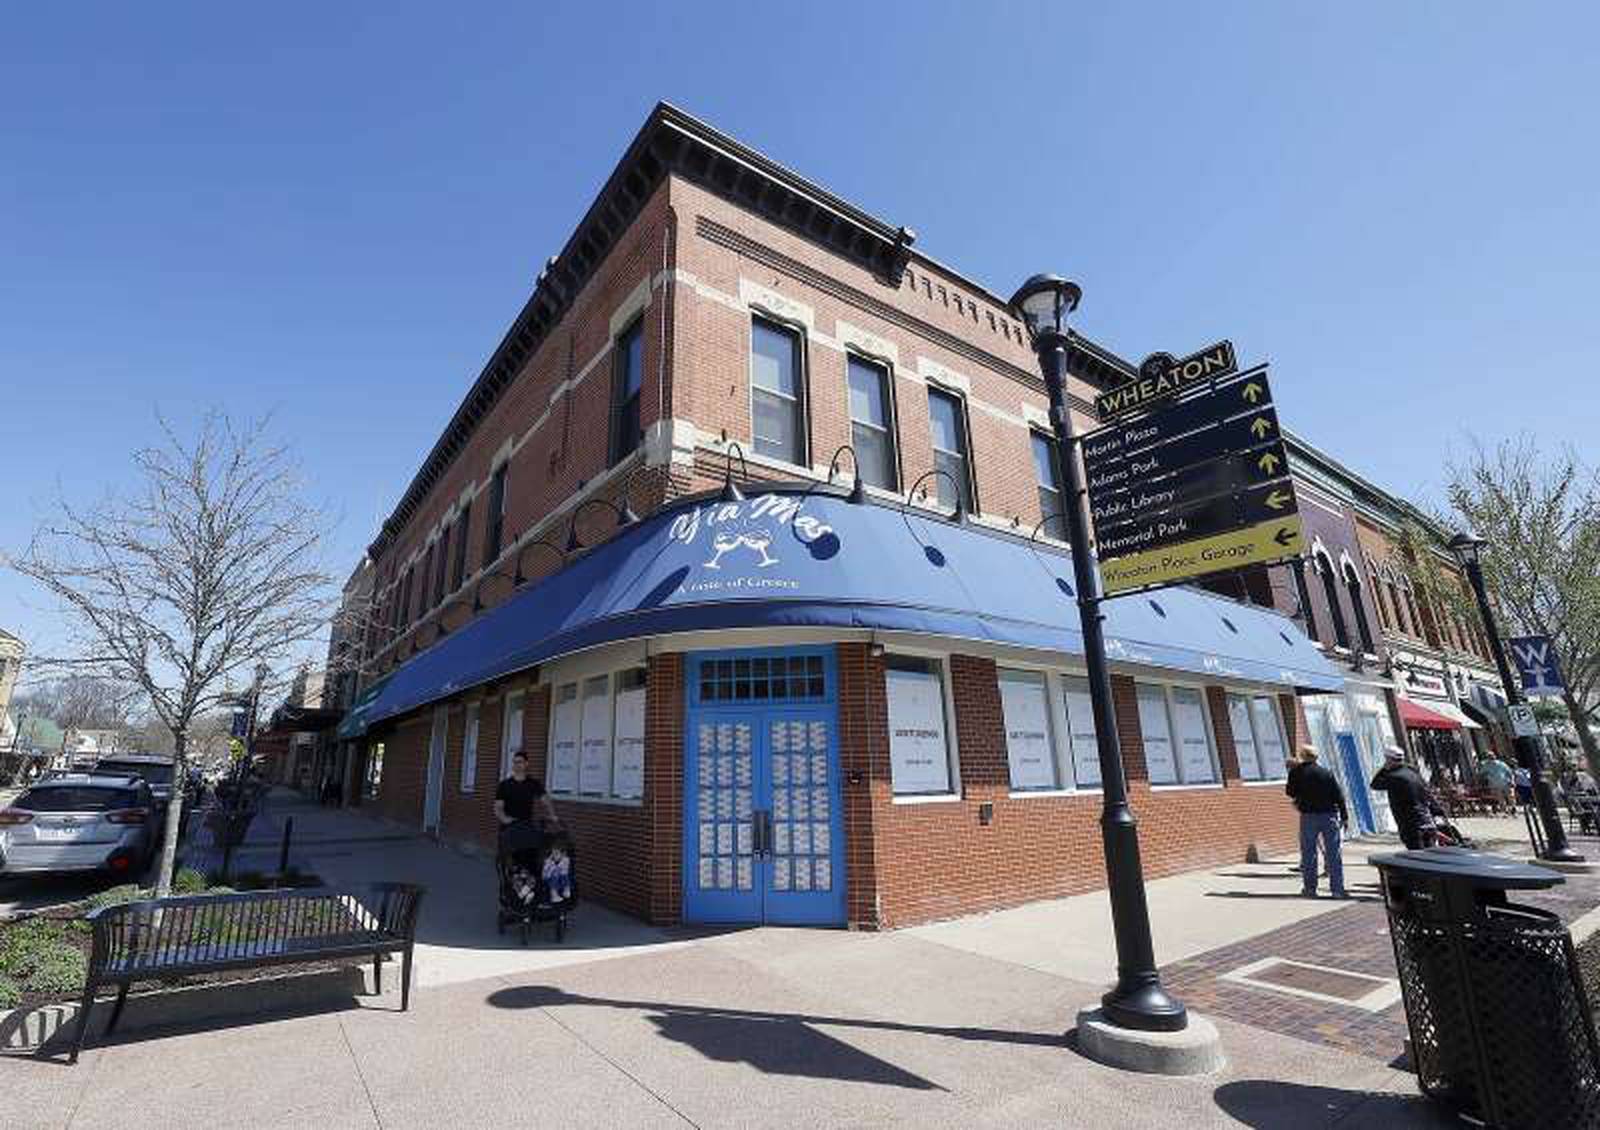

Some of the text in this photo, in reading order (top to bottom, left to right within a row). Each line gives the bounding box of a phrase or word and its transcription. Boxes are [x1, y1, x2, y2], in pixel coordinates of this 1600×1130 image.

[1101, 348, 1225, 412] WHEATON
[1131, 456, 1159, 475] Park
[1094, 488, 1176, 520] Public Library
[1099, 518, 1187, 552] Memorial Park
[1103, 562, 1158, 582] Wheaton
